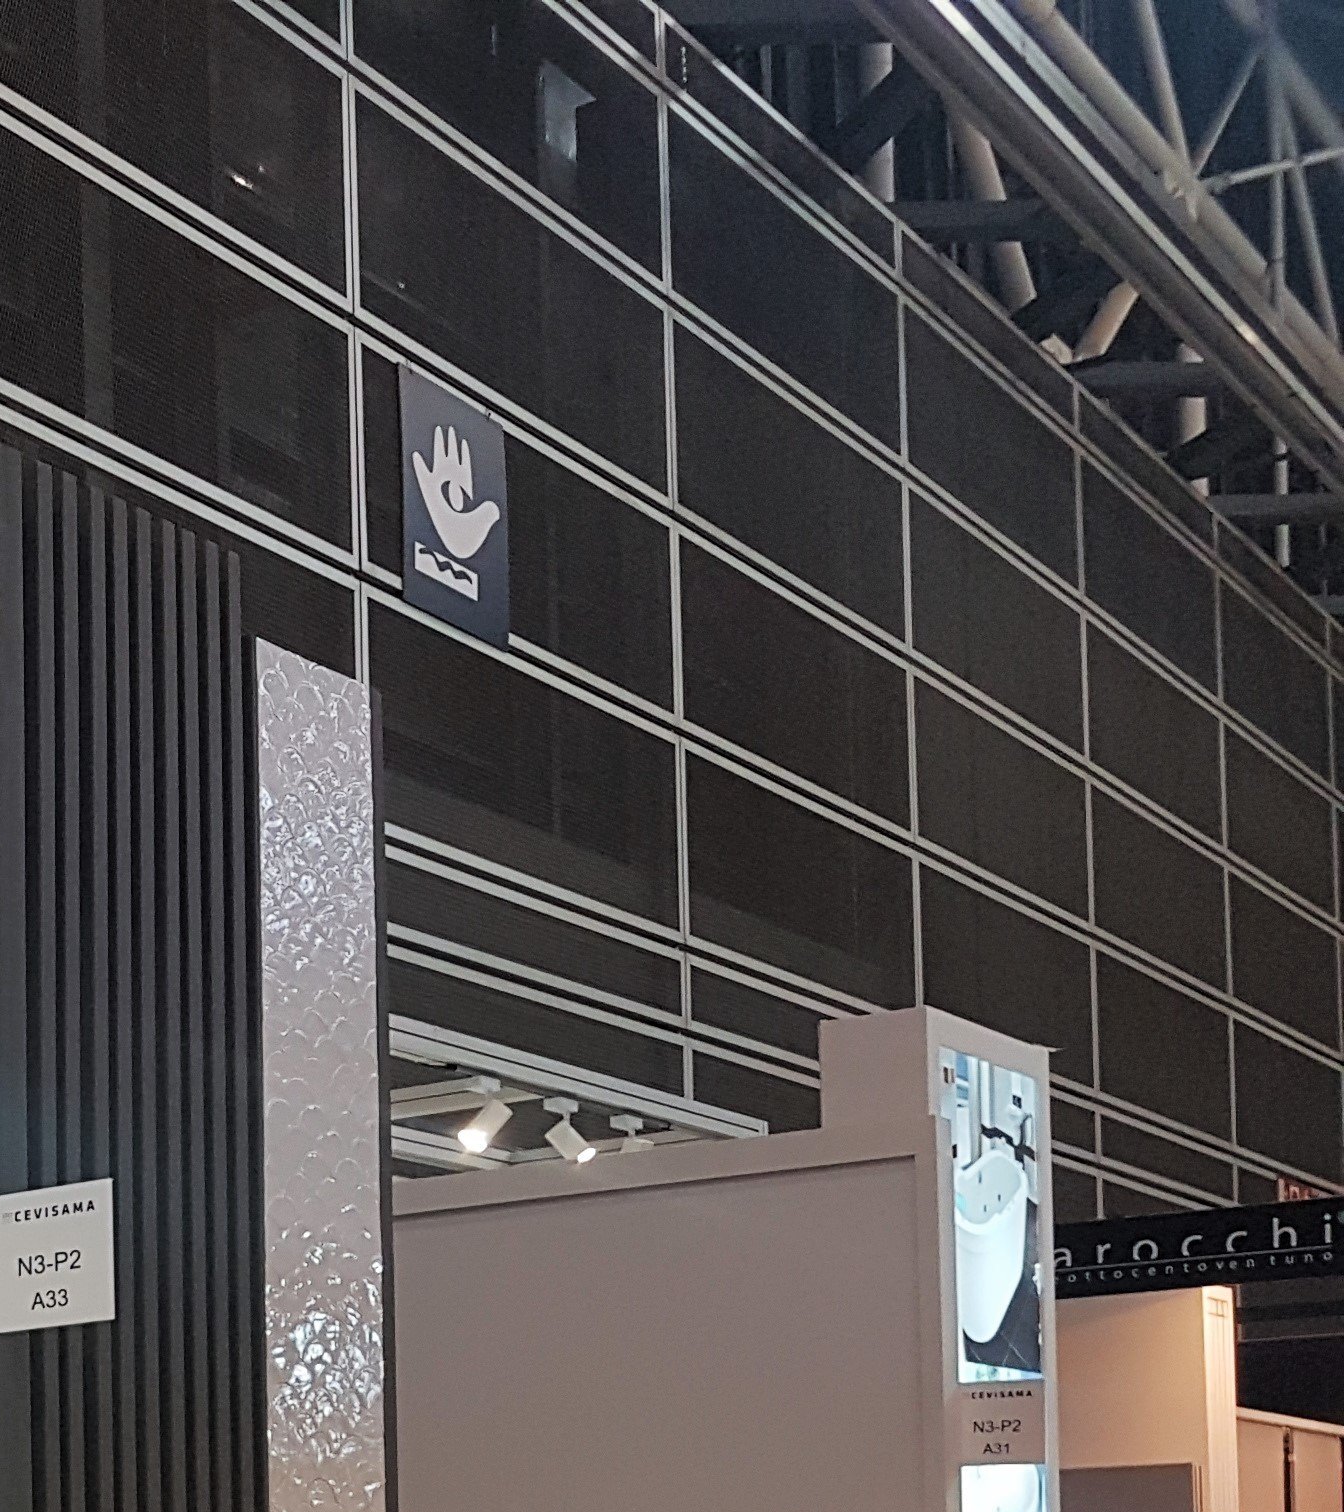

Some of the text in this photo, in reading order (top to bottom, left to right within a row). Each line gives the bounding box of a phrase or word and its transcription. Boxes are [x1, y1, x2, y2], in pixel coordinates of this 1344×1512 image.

[14, 1200, 95, 1222] CEVISAMA
[17, 1249, 82, 1277] N3-P2
[31, 1288, 70, 1311] A33
[971, 1389, 1033, 1400] CEVISAMA
[973, 1419, 1022, 1434] N3-P2
[982, 1442, 1010, 1455] A31
